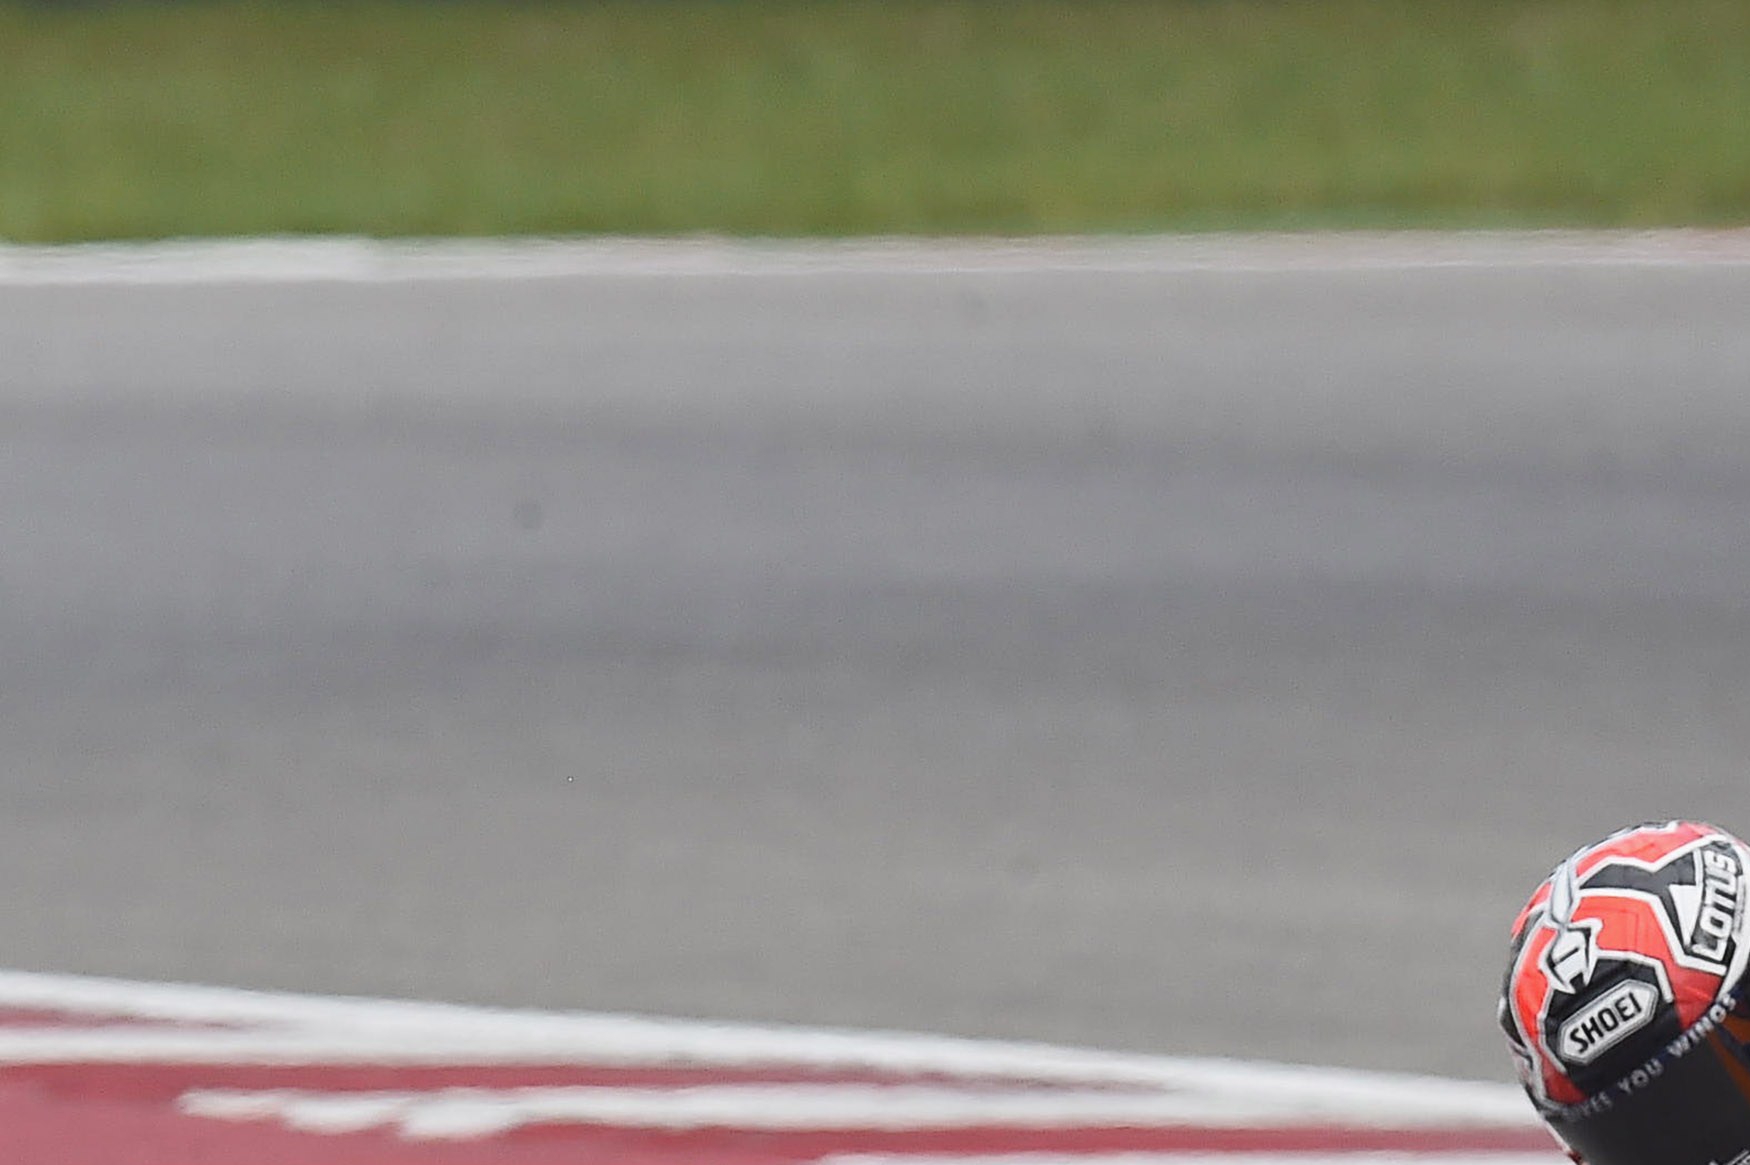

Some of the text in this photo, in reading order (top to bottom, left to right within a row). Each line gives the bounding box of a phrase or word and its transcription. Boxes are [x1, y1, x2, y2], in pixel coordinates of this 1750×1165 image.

[1691, 850, 1738, 962] LOTUS
[1569, 991, 1642, 1054] SHOEI
[1617, 1058, 1664, 1095] YOU
